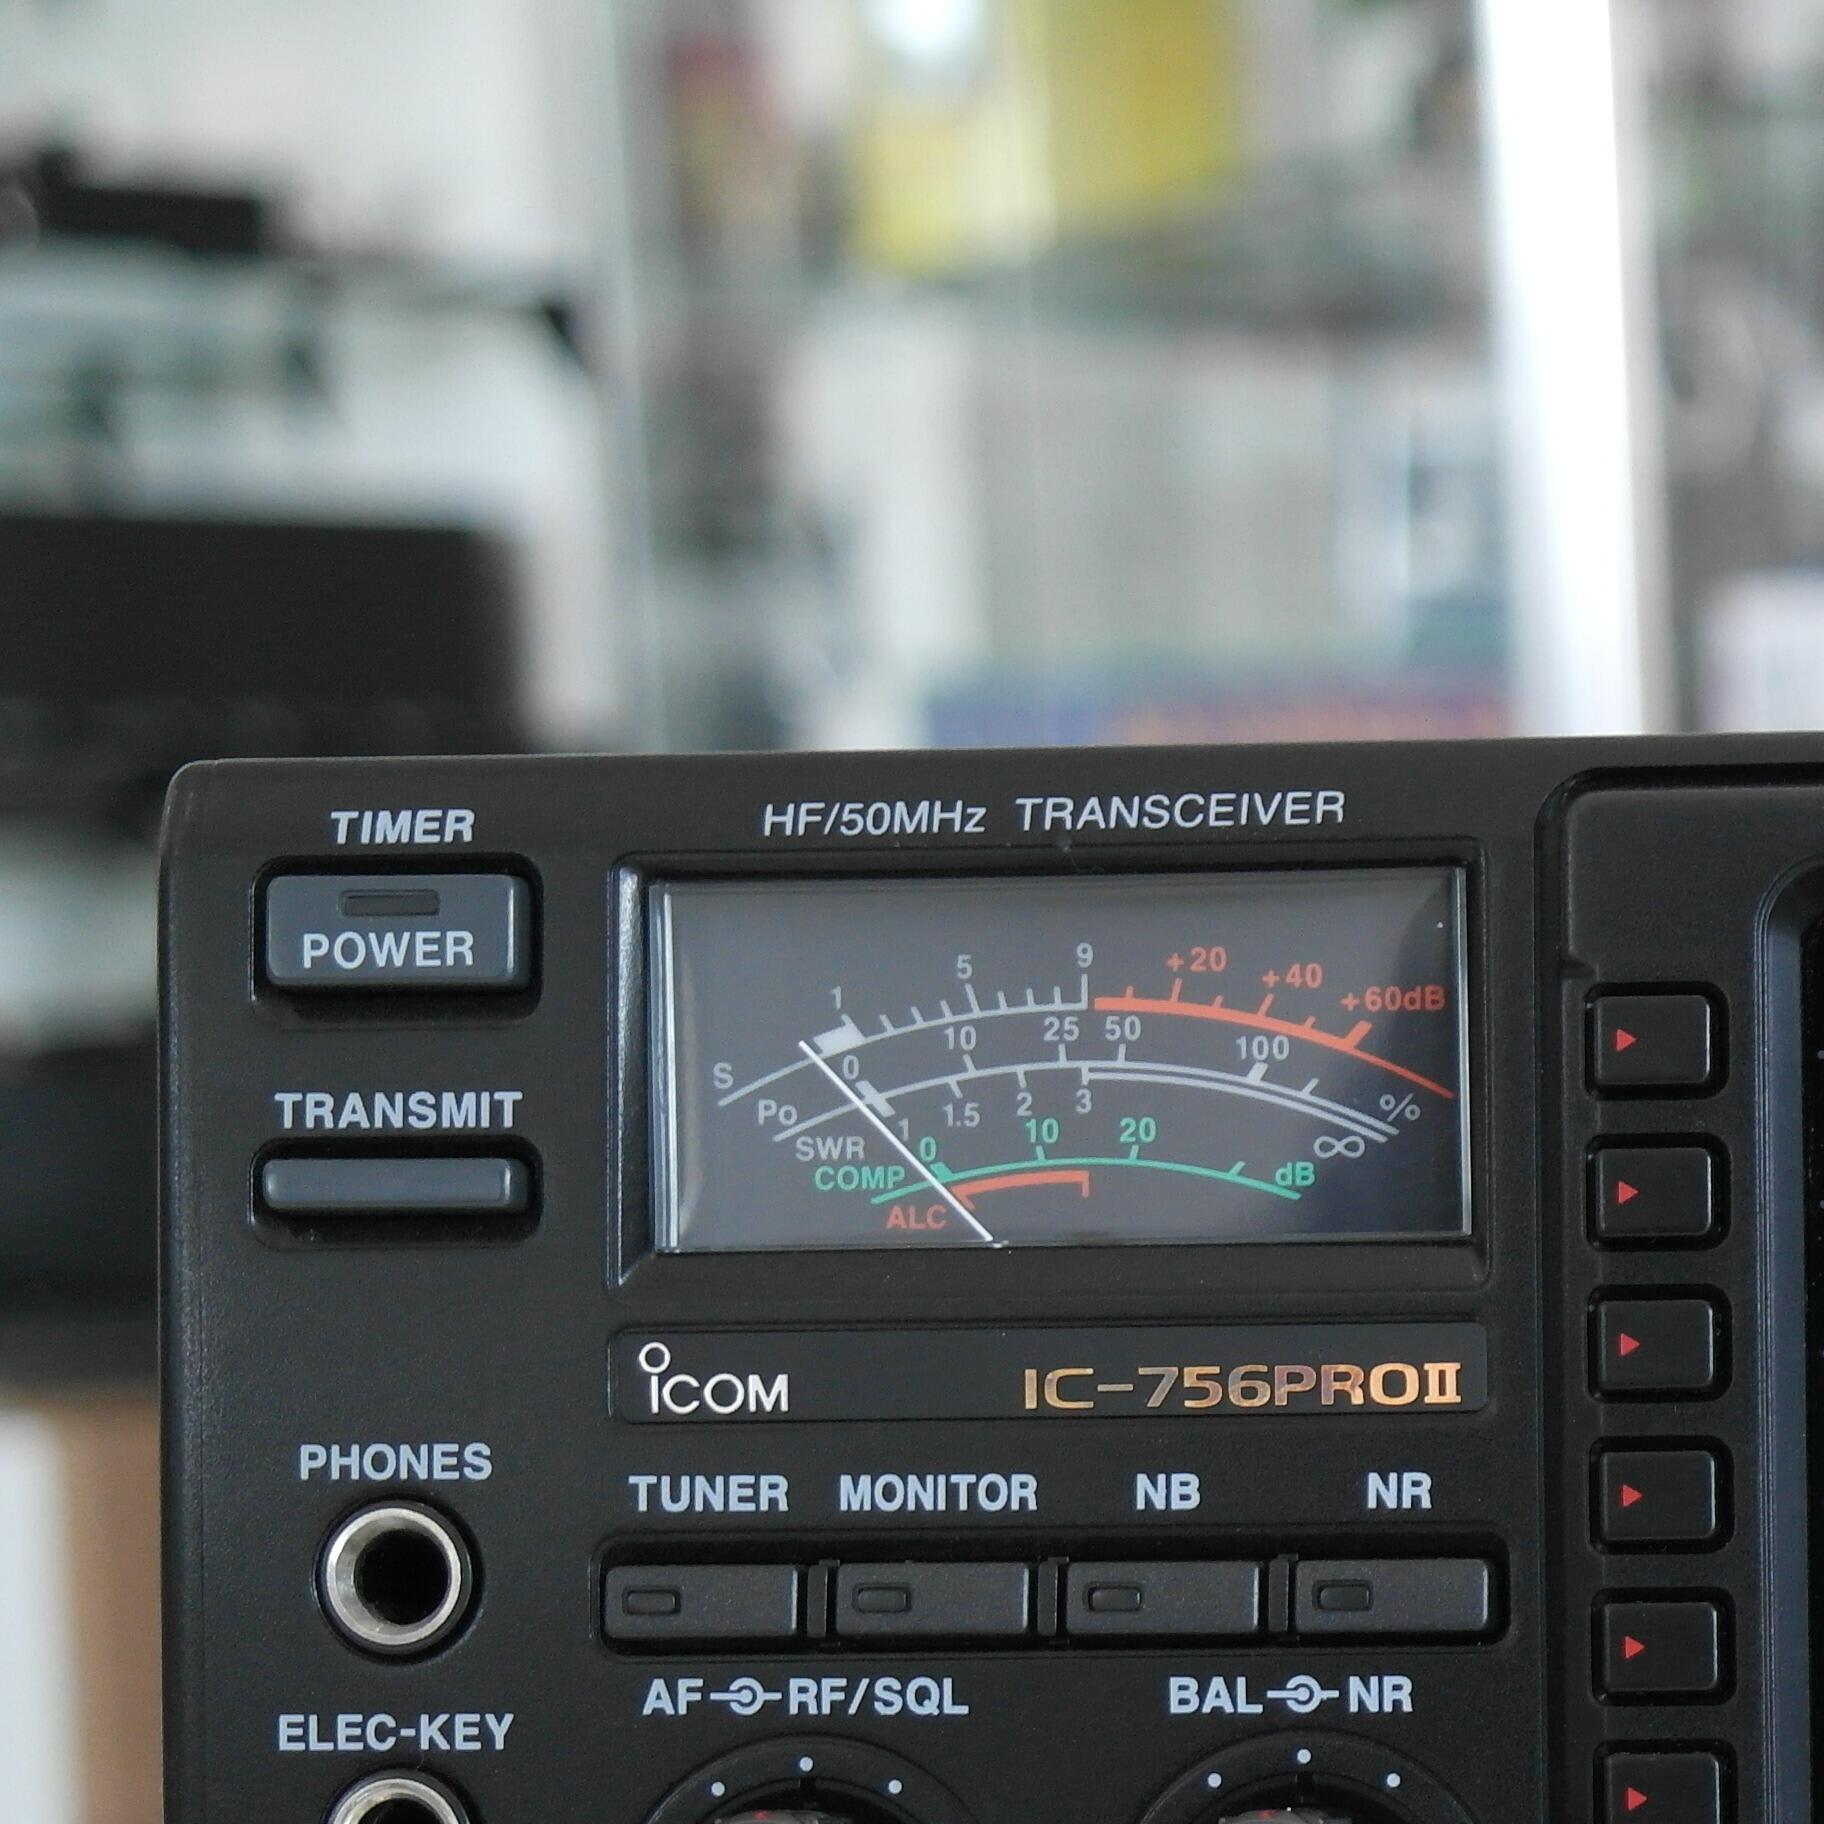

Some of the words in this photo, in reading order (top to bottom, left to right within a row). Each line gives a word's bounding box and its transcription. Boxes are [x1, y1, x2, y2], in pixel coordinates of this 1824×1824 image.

[330, 809, 475, 844] TIMER
[763, 799, 987, 837] HF/50MHz
[1015, 790, 1345, 831] TRANSCEIVER
[303, 930, 474, 969] POWER
[713, 1062, 734, 1089] S
[831, 986, 842, 1010] 1
[956, 954, 973, 980] 5
[1076, 942, 1094, 968] 9
[757, 1099, 798, 1126] Po
[842, 1054, 860, 1080] 0
[943, 1025, 977, 1051] 10
[1043, 1016, 1080, 1042] 25
[1105, 1015, 1141, 1041] 50
[1236, 1034, 1290, 1061] 100
[274, 1091, 523, 1129] TRANSMIT
[795, 1135, 864, 1162] SWR
[897, 1117, 909, 1142] 1
[942, 1102, 981, 1128] 1.5
[1016, 1091, 1033, 1117] 2
[1076, 1088, 1092, 1114] 3
[814, 1165, 905, 1191] COMP
[919, 1136, 937, 1163] 0
[1025, 1118, 1059, 1144] 10
[1119, 1117, 1156, 1143] 20
[1274, 1161, 1315, 1187] dB
[886, 1204, 946, 1230] ALC
[300, 1442, 492, 1481] PHONES
[628, 1474, 789, 1513] TUNER
[839, 1473, 1038, 1512] MONITOR
[1136, 1472, 1201, 1511] NB
[1367, 1471, 1432, 1509] NR
[642, 1678, 704, 1716] AF
[789, 1676, 970, 1716] RF/SQL
[1169, 1676, 1264, 1714] BAL
[1349, 1675, 1413, 1713] NR
[278, 1713, 514, 1751] ELEC-KEY
